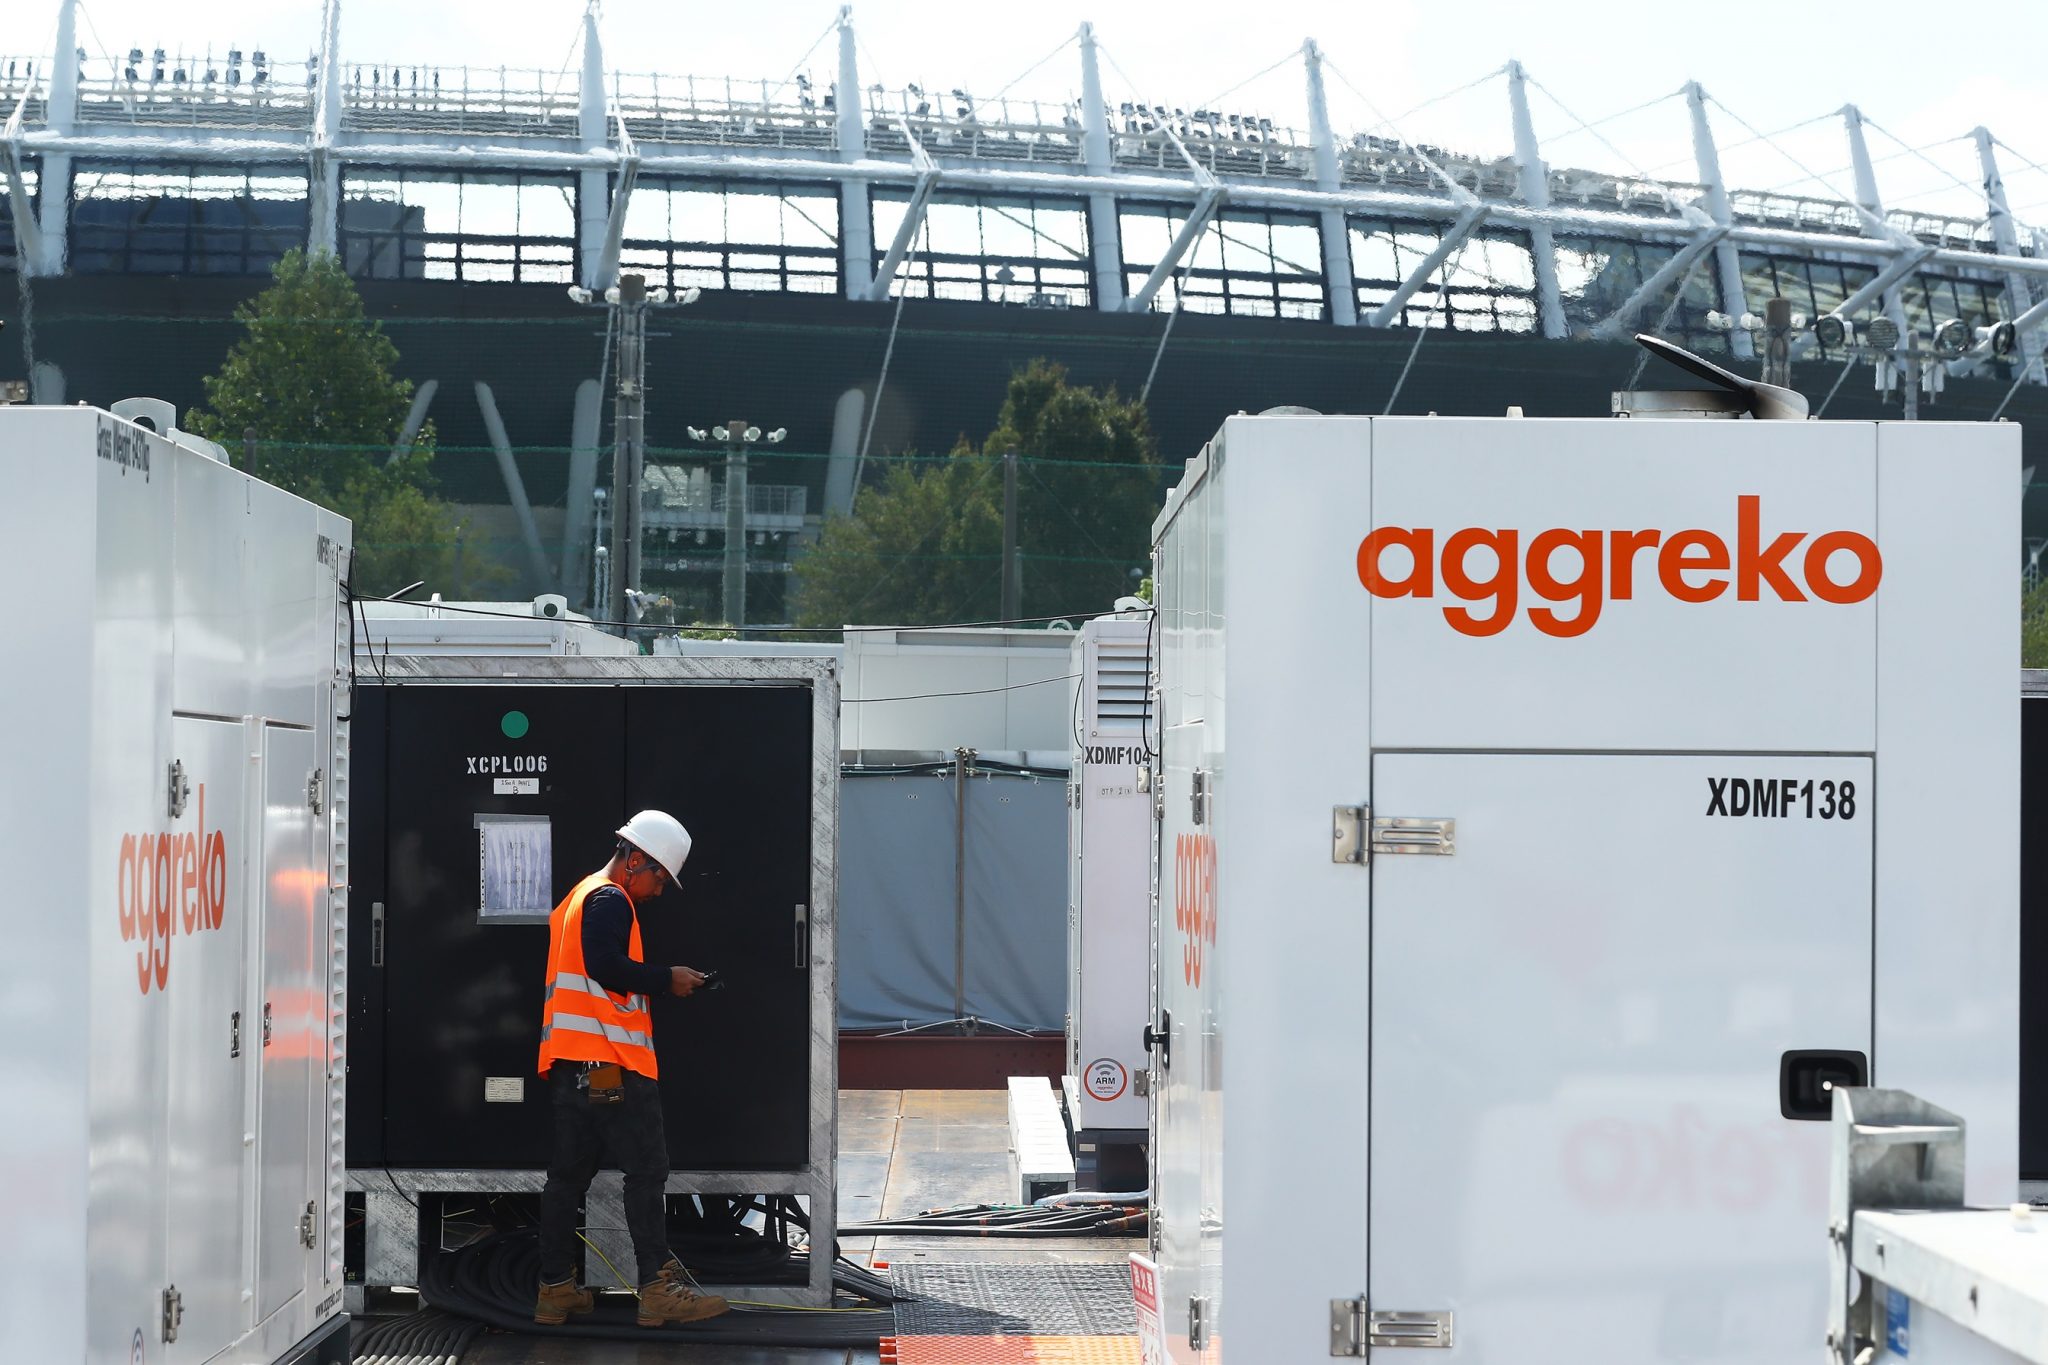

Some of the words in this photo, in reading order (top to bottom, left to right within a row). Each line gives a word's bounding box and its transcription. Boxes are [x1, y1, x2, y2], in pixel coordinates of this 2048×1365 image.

[1356, 495, 1883, 637] aggreko
[466, 755, 548, 774] XCPL006
[1085, 746, 1151, 765] XDMF104
[1705, 777, 1856, 820] XDMF138
[118, 783, 226, 994] aggreko
[1095, 1077, 1116, 1085] ARM
